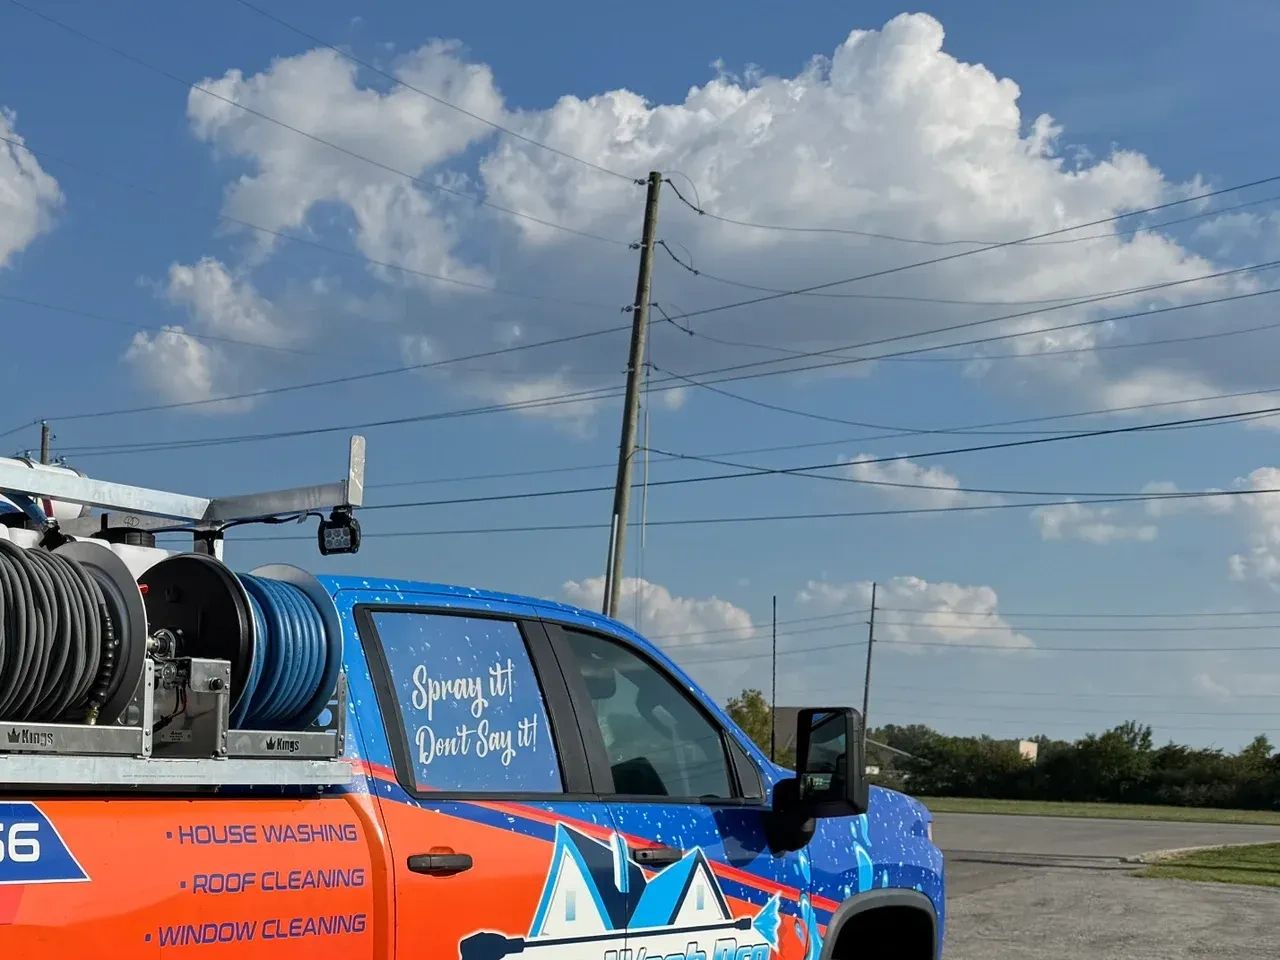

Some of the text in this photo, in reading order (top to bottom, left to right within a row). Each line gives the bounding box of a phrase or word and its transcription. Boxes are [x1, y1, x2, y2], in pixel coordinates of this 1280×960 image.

[412, 657, 514, 721] Spray it!
[22, 729, 54, 746] Kings
[276, 737, 300, 752] Kings
[476, 718, 516, 766] Say
[517, 713, 537, 752] it!
[178, 823, 358, 845] HOUSE WASHING
[192, 867, 365, 894] ROOF CLEANING
[158, 914, 366, 947] WINDOW CLEANING
